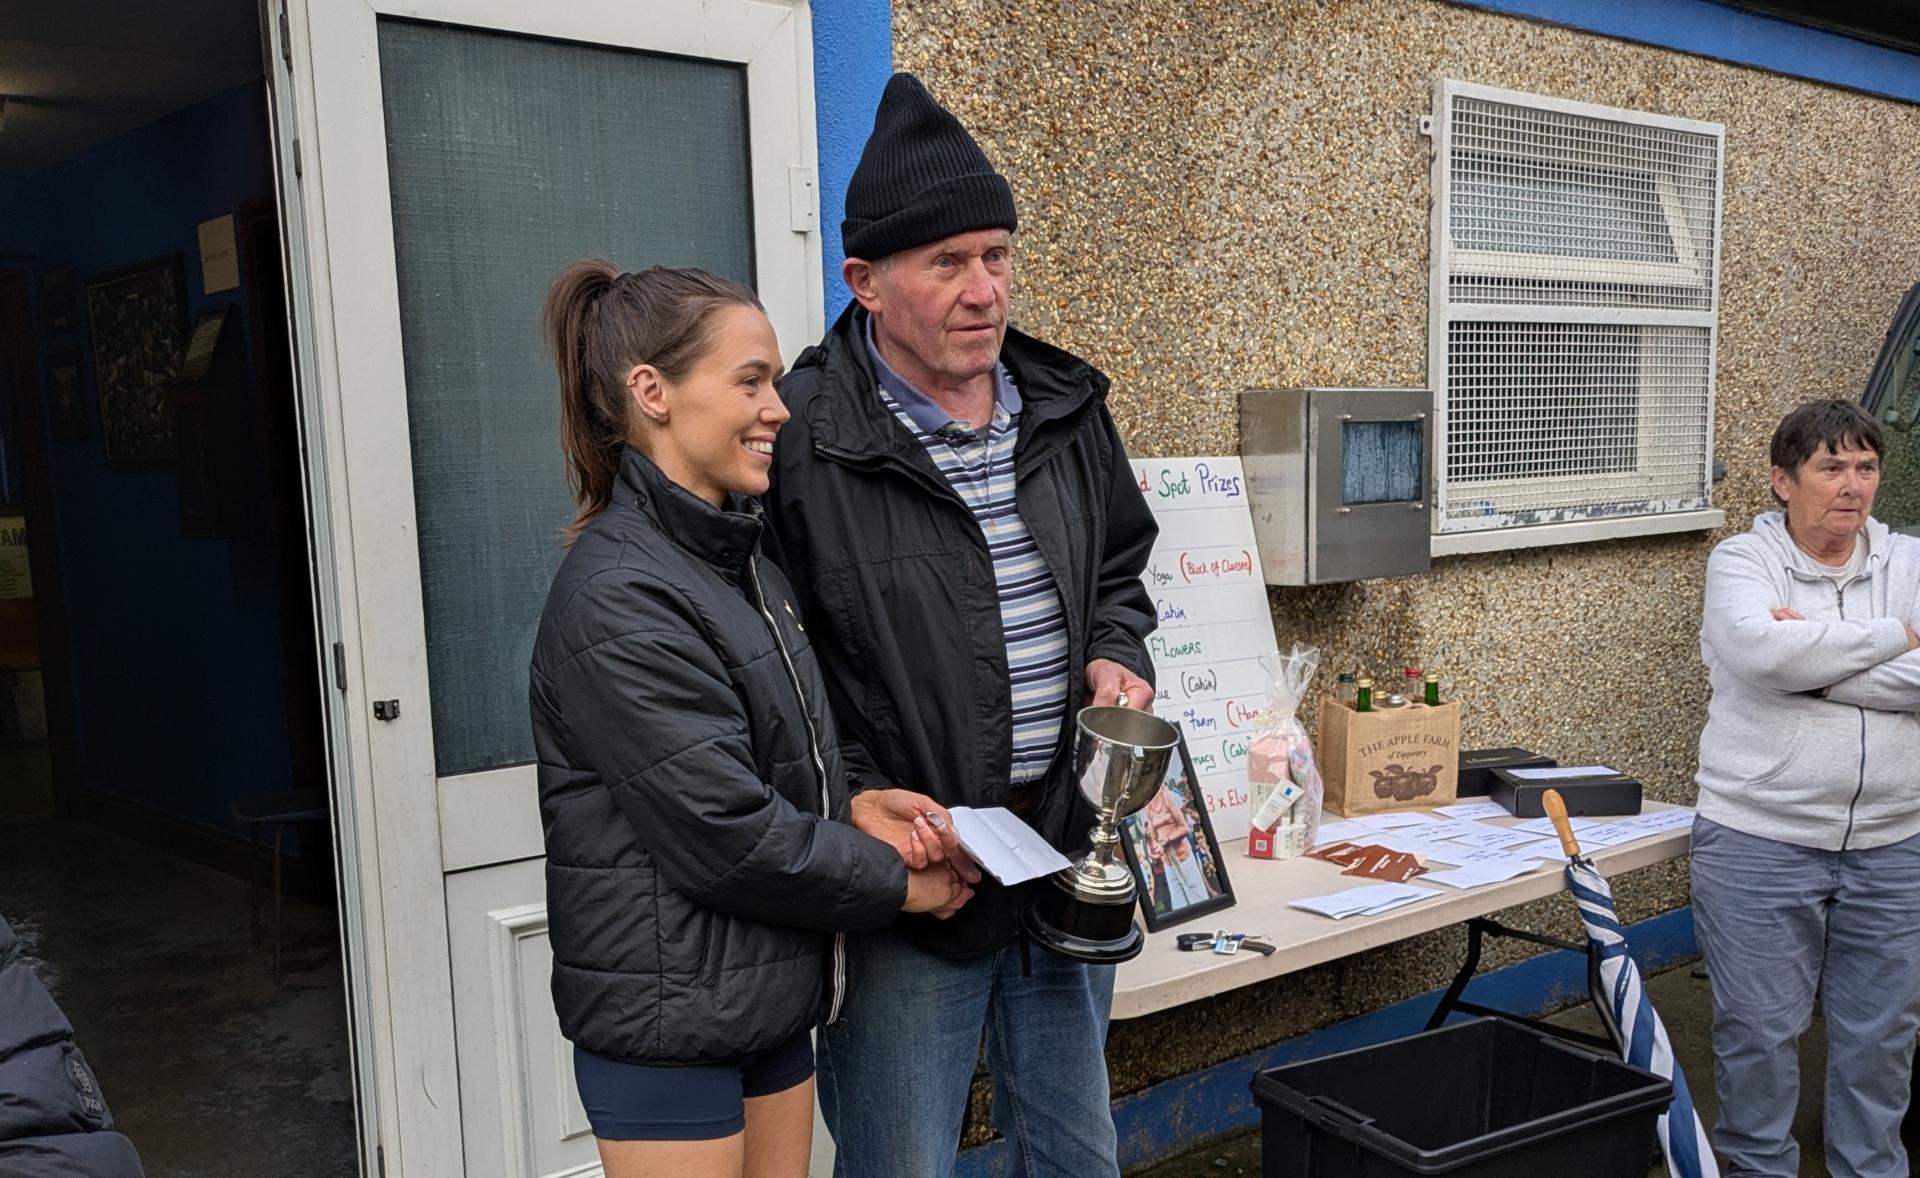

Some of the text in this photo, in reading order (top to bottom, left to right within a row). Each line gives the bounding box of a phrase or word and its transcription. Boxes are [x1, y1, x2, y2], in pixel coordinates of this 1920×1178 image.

[1158, 469, 1190, 499] Spot
[1195, 463, 1240, 498] Prizes
[1147, 564, 1173, 586] Yoga
[1180, 552, 1208, 583] (Block
[1211, 560, 1220, 577] of
[1358, 734, 1450, 758] THE APPLE FARM
[1191, 753, 1216, 772] macy
[1206, 794, 1216, 813] 3
